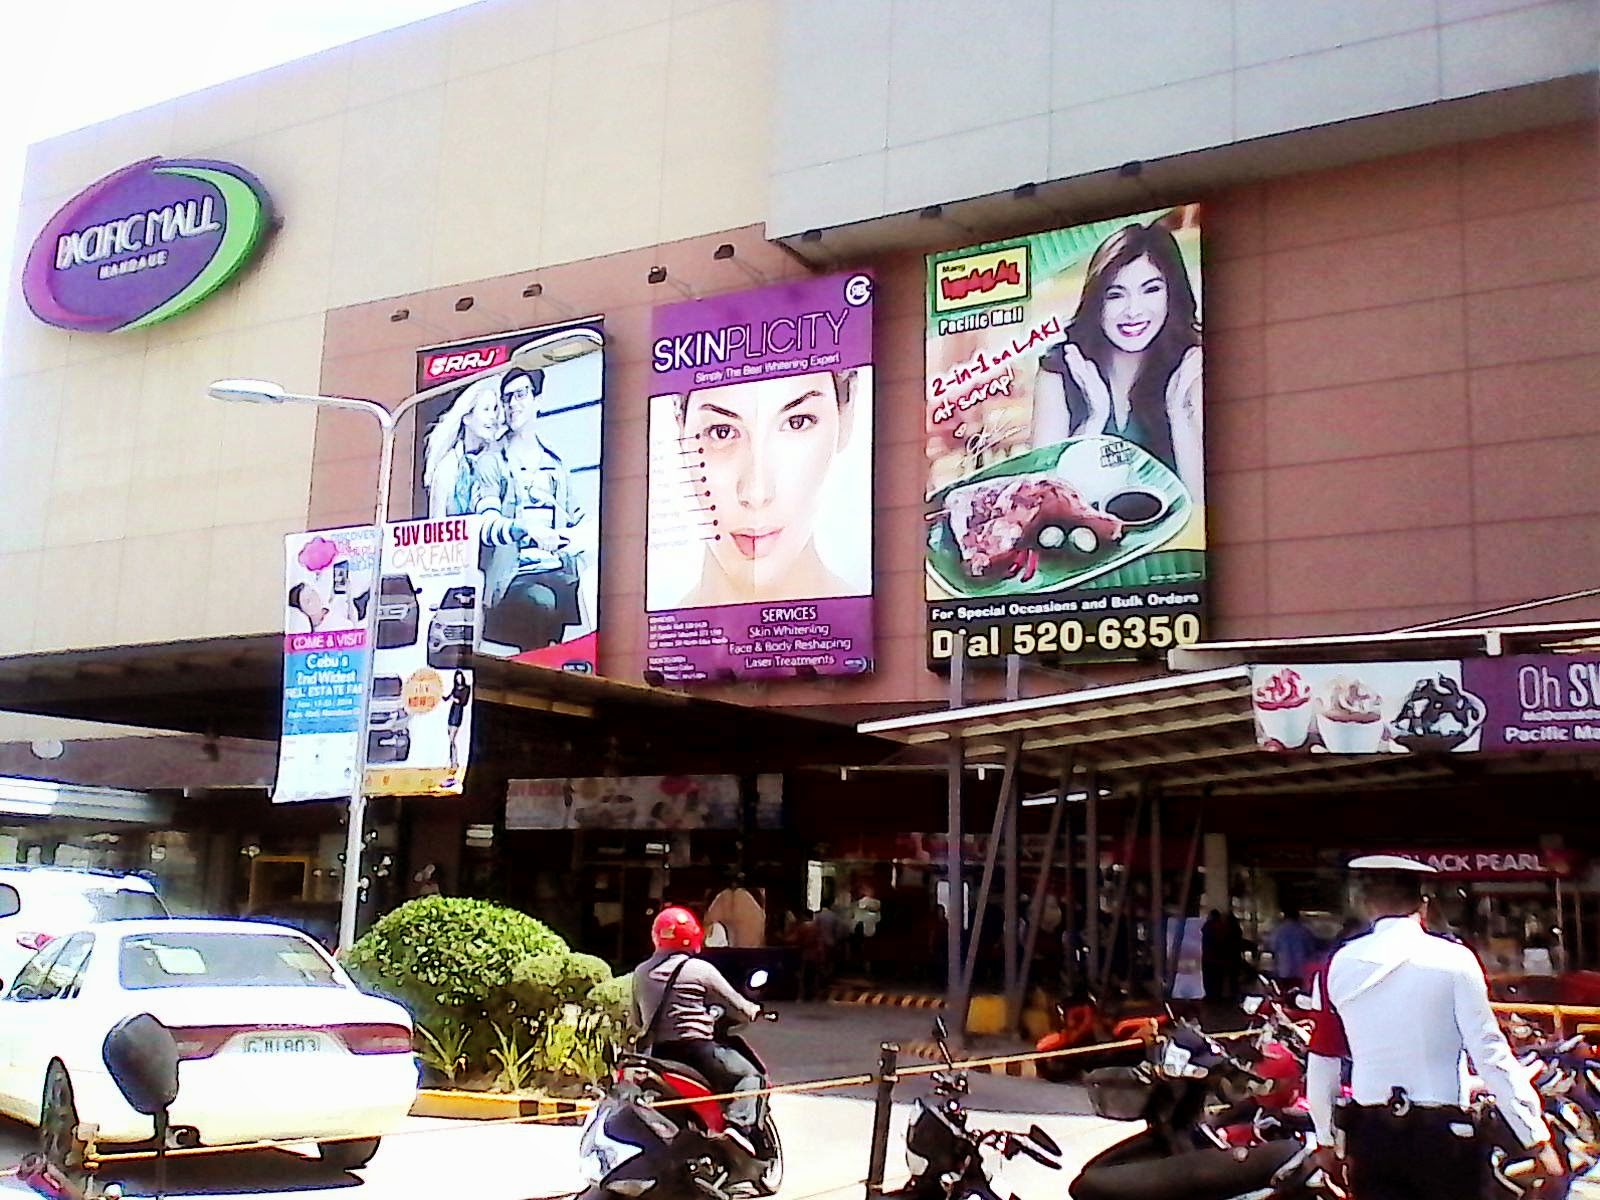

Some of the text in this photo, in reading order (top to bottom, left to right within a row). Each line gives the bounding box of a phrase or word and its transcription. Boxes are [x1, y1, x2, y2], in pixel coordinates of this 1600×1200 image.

[57, 196, 222, 270] PACIFIC MALL
[939, 306, 1024, 336] Pacific Mall
[653, 309, 849, 373] SKINPLICITY
[695, 353, 840, 384] Simply The Best Whitening Expert
[932, 353, 991, 397] 2-in-1
[393, 519, 469, 547] SUV DIESEL
[392, 546, 430, 571] CAR
[430, 542, 470, 568] FAIR
[761, 606, 817, 623] SERVICES
[931, 593, 1199, 622] For Special Occasions and Bulk Orders
[292, 636, 325, 651] COME
[337, 631, 363, 647] VISIT
[749, 624, 830, 638] Skin Whitening
[931, 613, 1200, 660] Dal 520-6350
[729, 643, 752, 654] Face
[754, 642, 763, 652] &
[765, 641, 793, 652] Body
[794, 638, 852, 651] Reshaping
[745, 658, 772, 669] Laser
[775, 655, 836, 667] Treatments
[308, 685, 345, 697] ESTATE
[1518, 665, 1562, 710] Oh
[1504, 725, 1570, 742] Pacific
[1475, 853, 1549, 872] PEARL
